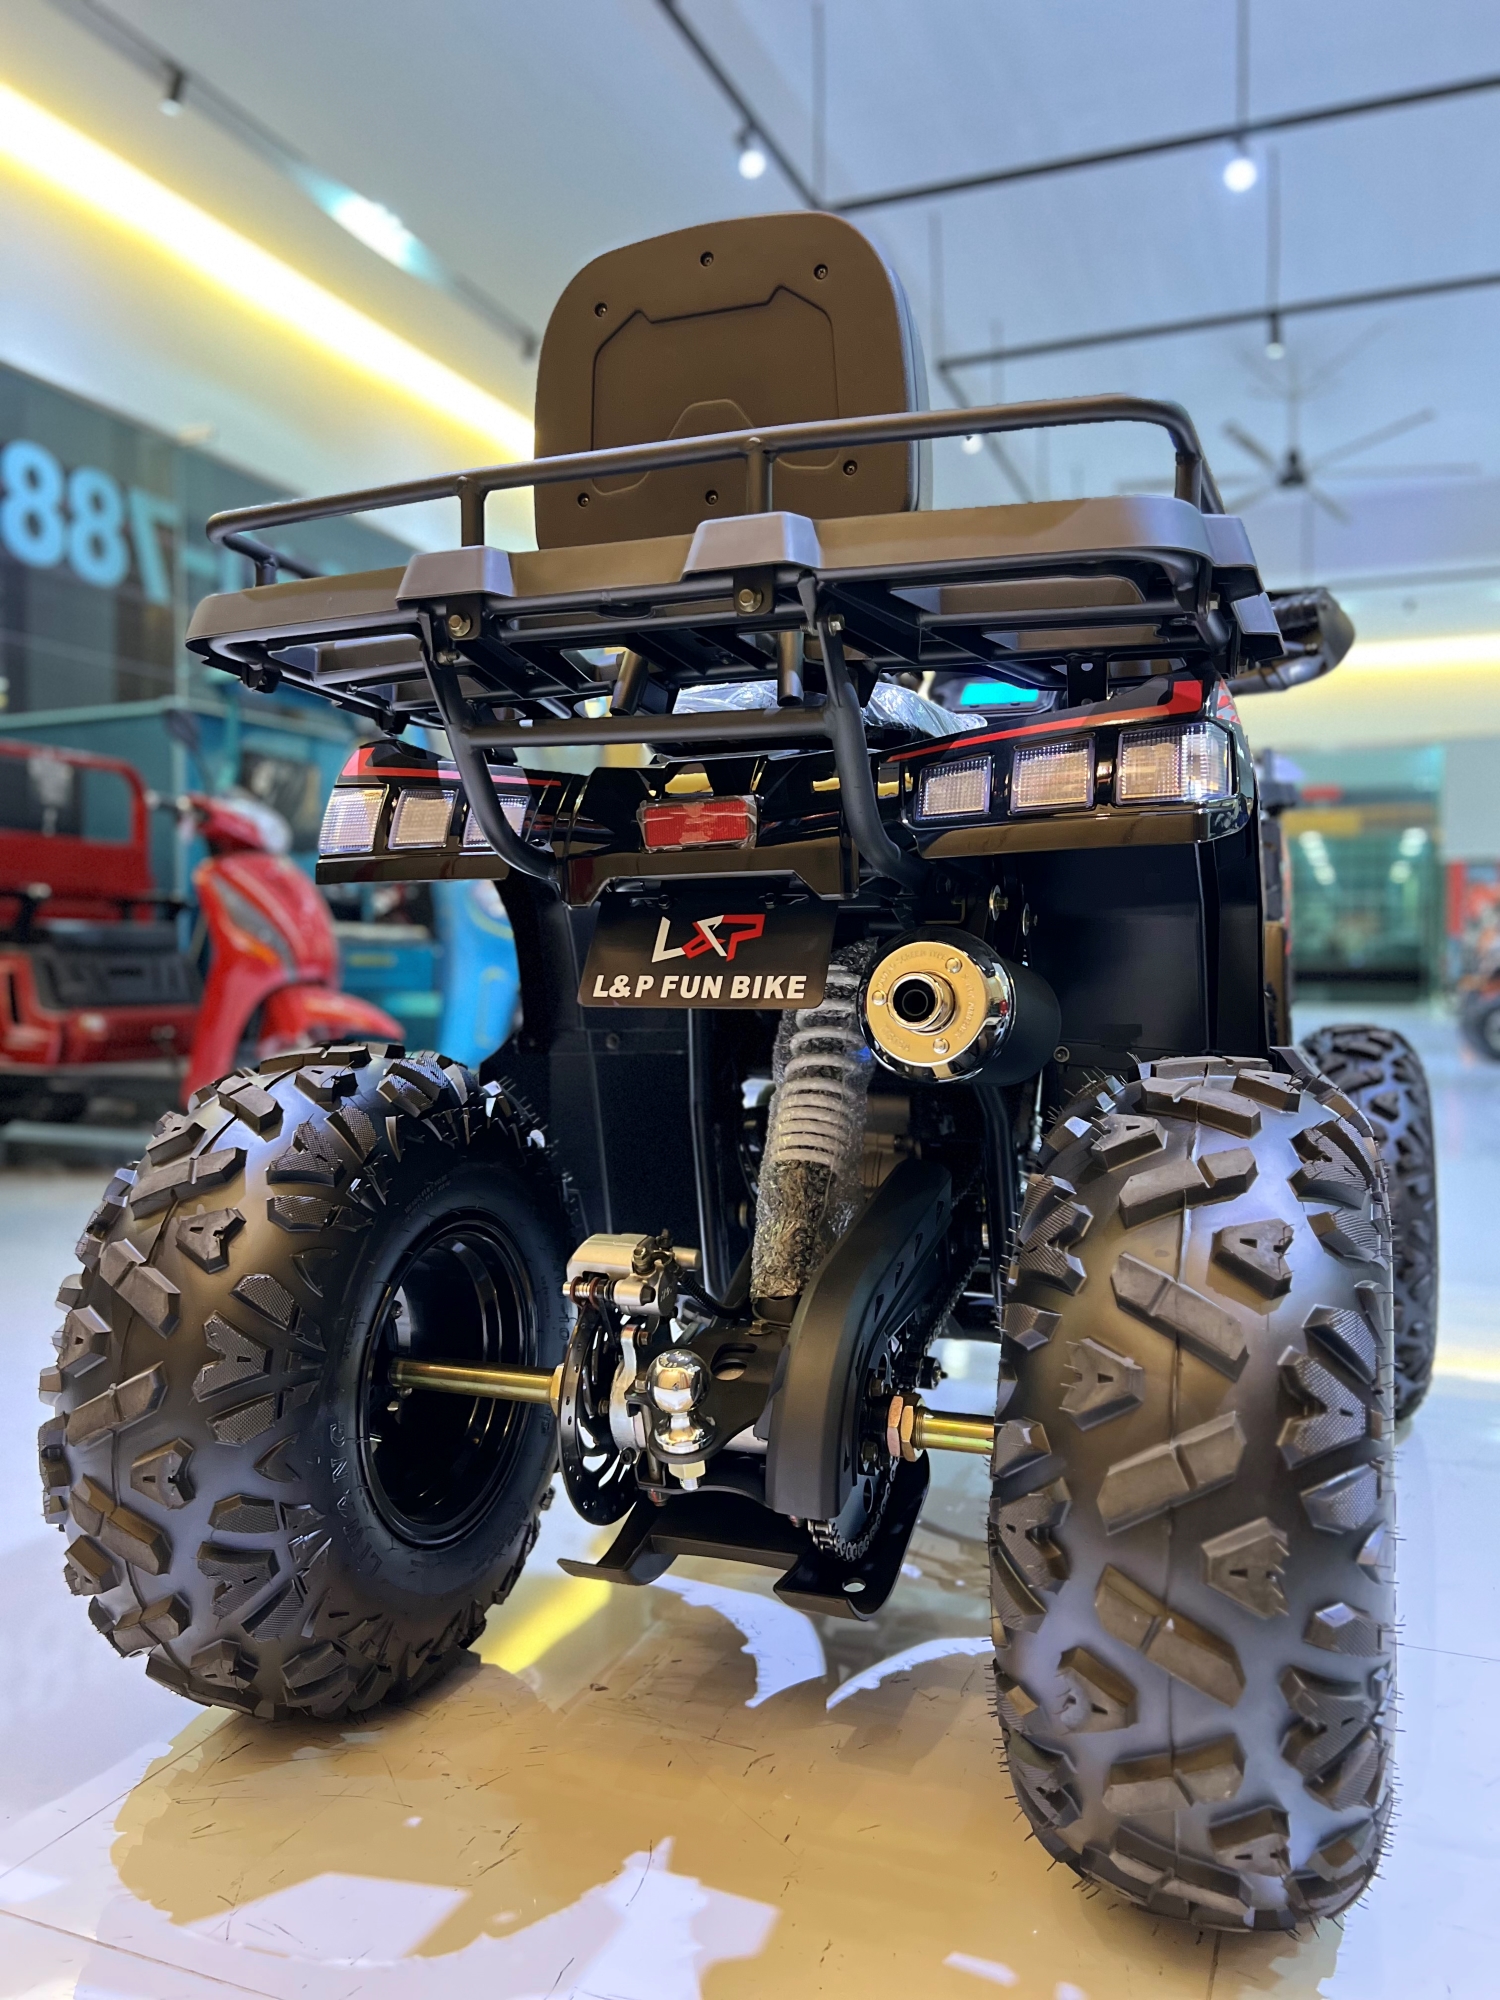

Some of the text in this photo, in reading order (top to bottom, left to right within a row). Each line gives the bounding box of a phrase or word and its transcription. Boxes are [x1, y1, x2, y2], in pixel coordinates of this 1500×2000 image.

[592, 973, 808, 1000] L&P FUN BIKE
